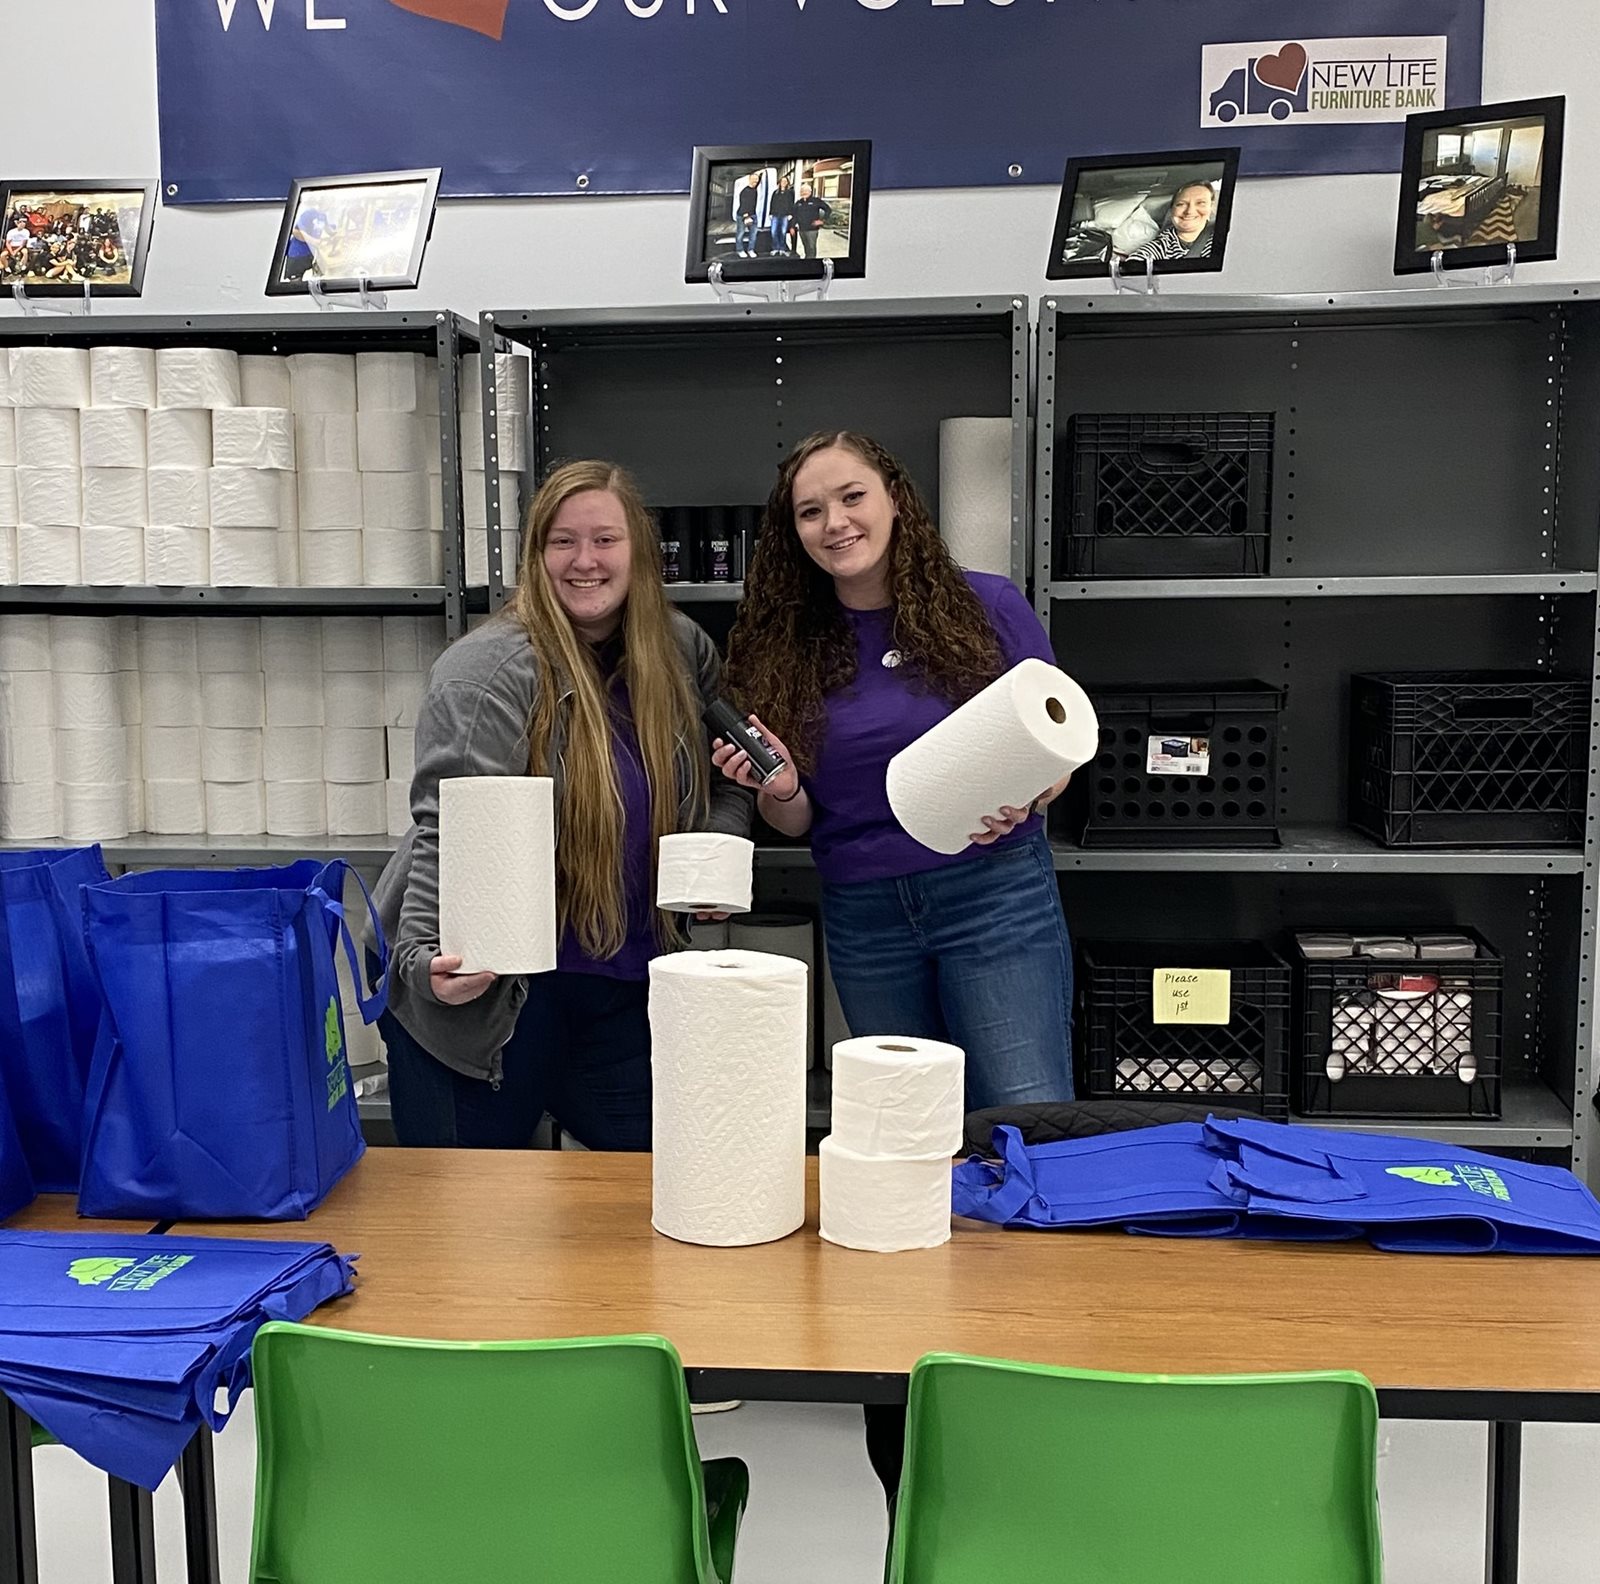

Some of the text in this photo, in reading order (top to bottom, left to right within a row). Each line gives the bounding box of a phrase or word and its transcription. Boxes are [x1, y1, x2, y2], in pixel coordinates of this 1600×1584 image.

[1312, 54, 1437, 88] NEW LIFE
[1312, 88, 1436, 110] FURNITURE BANK
[1165, 973, 1199, 983] Please
[1172, 989, 1190, 998] use
[1176, 1000, 1189, 1016] 1st
